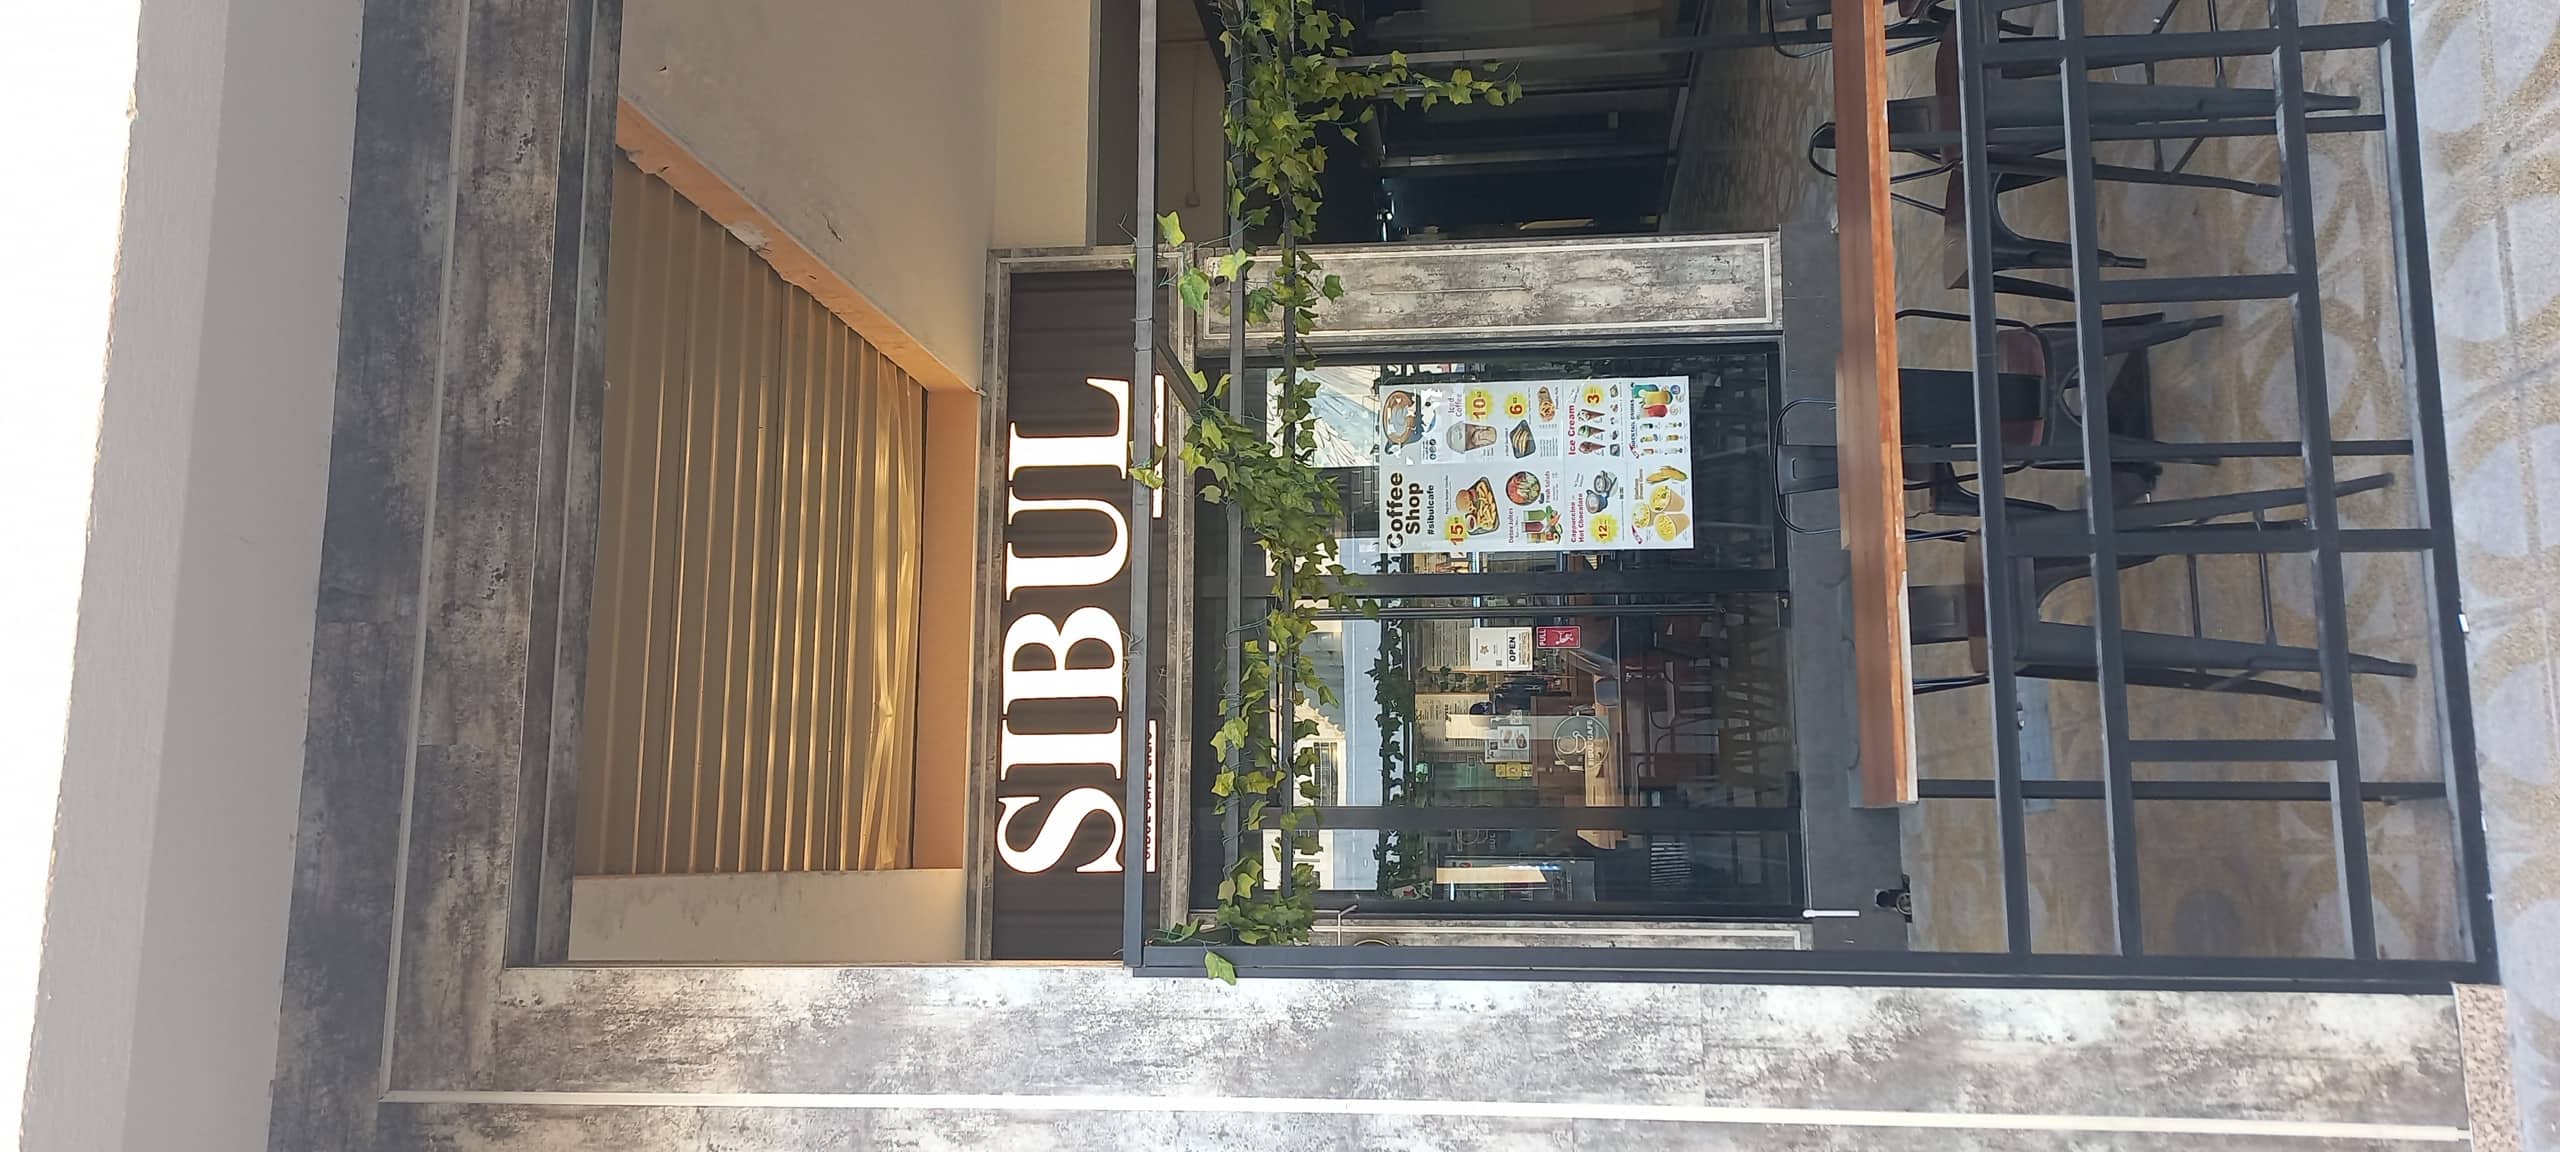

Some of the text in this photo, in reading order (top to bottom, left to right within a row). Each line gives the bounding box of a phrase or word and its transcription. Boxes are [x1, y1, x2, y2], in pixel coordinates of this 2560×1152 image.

[1472, 398, 1486, 419] 10
[1510, 404, 1523, 415] 6
[1586, 394, 1600, 404] 3
[1567, 404, 1576, 437] Cream
[1568, 440, 1576, 455] Ice
[1386, 472, 1404, 549] Coffee
[1406, 482, 1423, 535] Shop
[1426, 484, 1435, 535] #sibulcafe
[1450, 524, 1464, 545] 15
[1598, 524, 1608, 539] 12
[996, 377, 1129, 874] SIBUL
[1508, 636, 1516, 662] OPEN
[1586, 720, 1594, 740] CAFE
